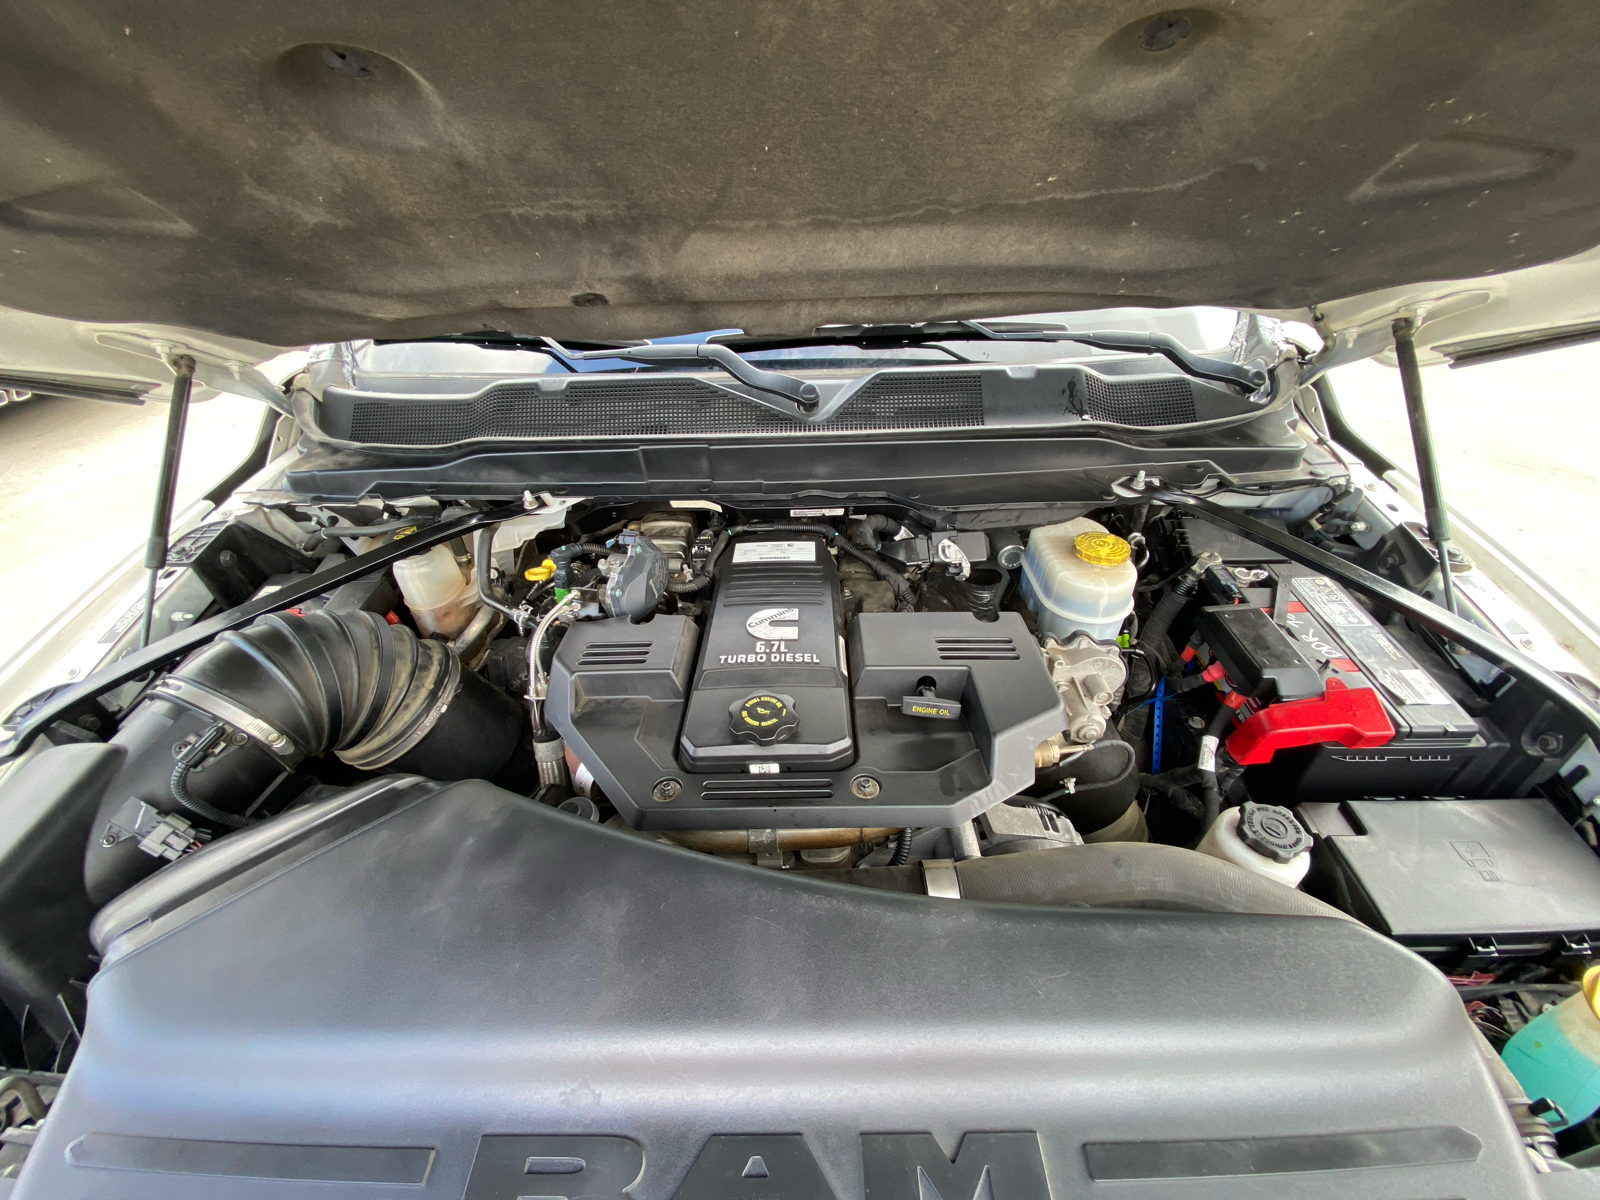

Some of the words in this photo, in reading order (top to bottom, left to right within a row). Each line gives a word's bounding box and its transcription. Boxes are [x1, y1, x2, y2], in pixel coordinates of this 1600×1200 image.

[748, 608, 794, 628] Cummins
[755, 641, 788, 653] 6.7L
[719, 653, 767, 664] TURBO
[770, 653, 820, 663] DIESEL
[912, 705, 938, 715] ENGINE
[939, 708, 950, 716] OIL
[462, 1131, 1054, 1200] RAM
